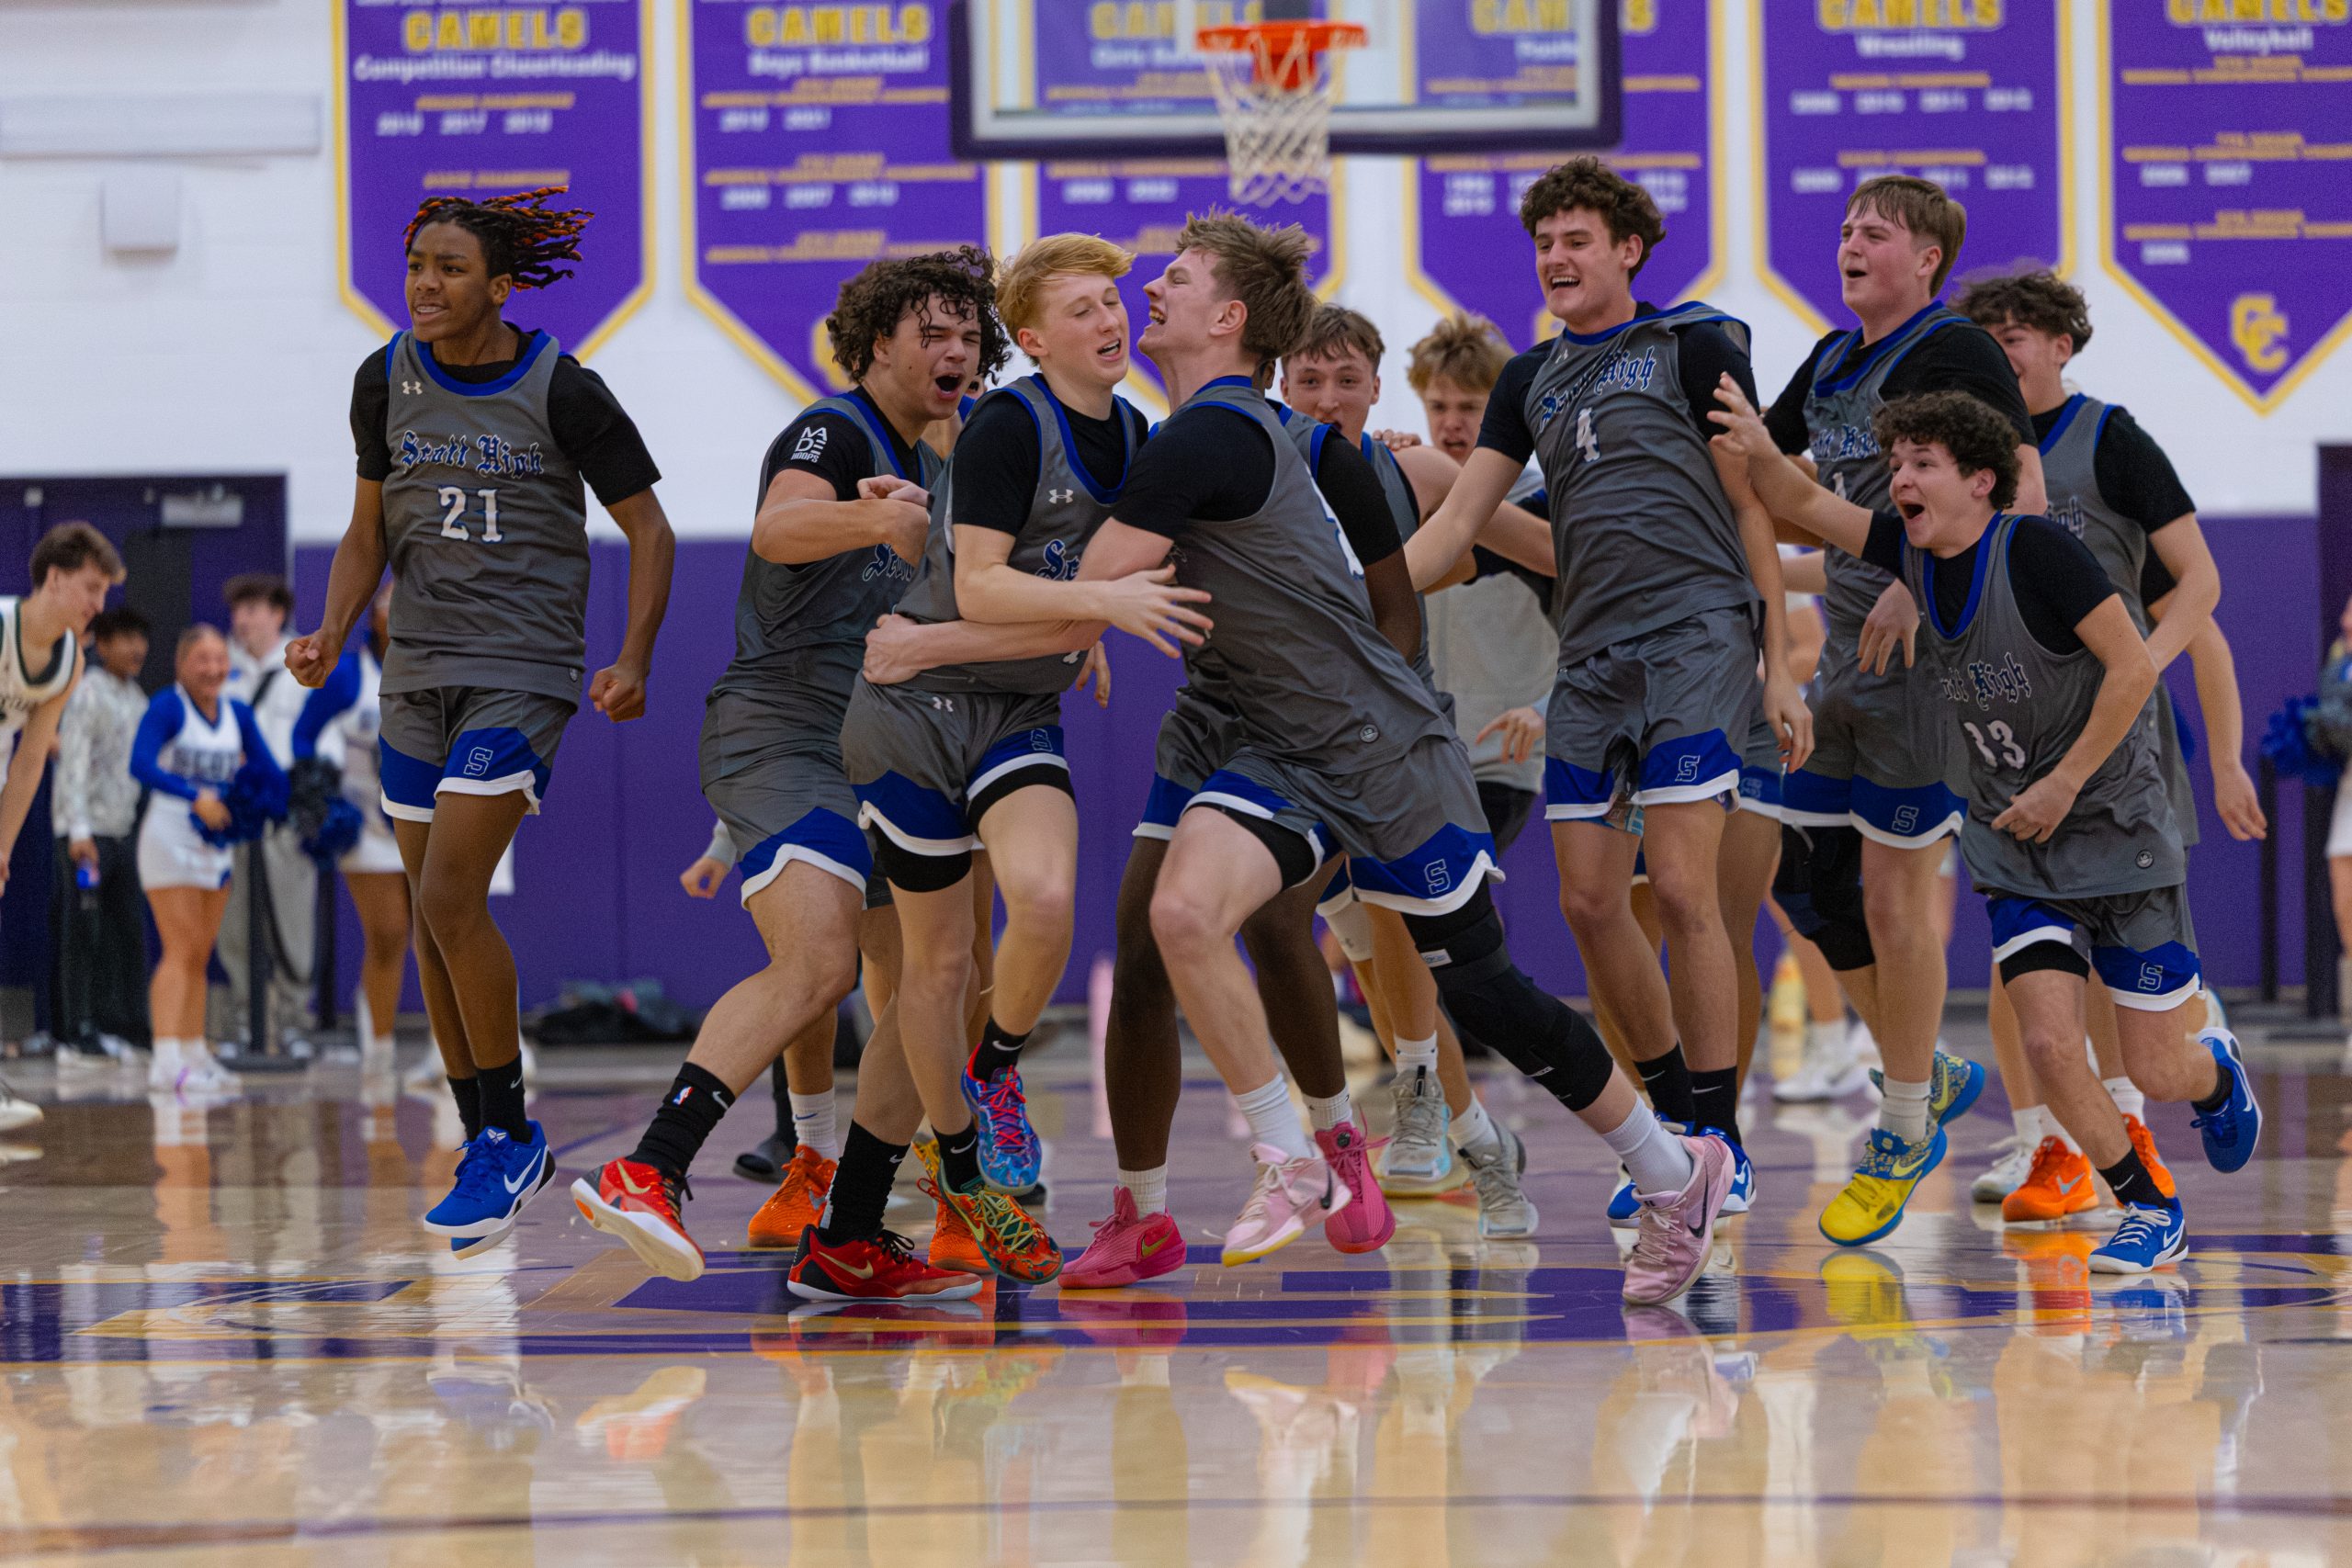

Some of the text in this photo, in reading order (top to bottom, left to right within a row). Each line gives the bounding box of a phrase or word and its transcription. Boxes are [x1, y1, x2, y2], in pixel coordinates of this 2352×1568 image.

[746, 6, 933, 48] CAMELS
[1818, 0, 2001, 31] CAMELS
[2167, 0, 2349, 25] CAMELS
[403, 9, 588, 51] CAMELS
[2205, 28, 2312, 55] Volleyball
[1575, 407, 1601, 463] 4
[401, 431, 545, 479] Scott High
[438, 485, 504, 544] 21
[1962, 719, 2026, 770] 13
[464, 747, 493, 777] S
[1675, 754, 1701, 783] S
[1891, 804, 1918, 834] S
[1424, 859, 1452, 896] S
[2138, 961, 2163, 992] S
